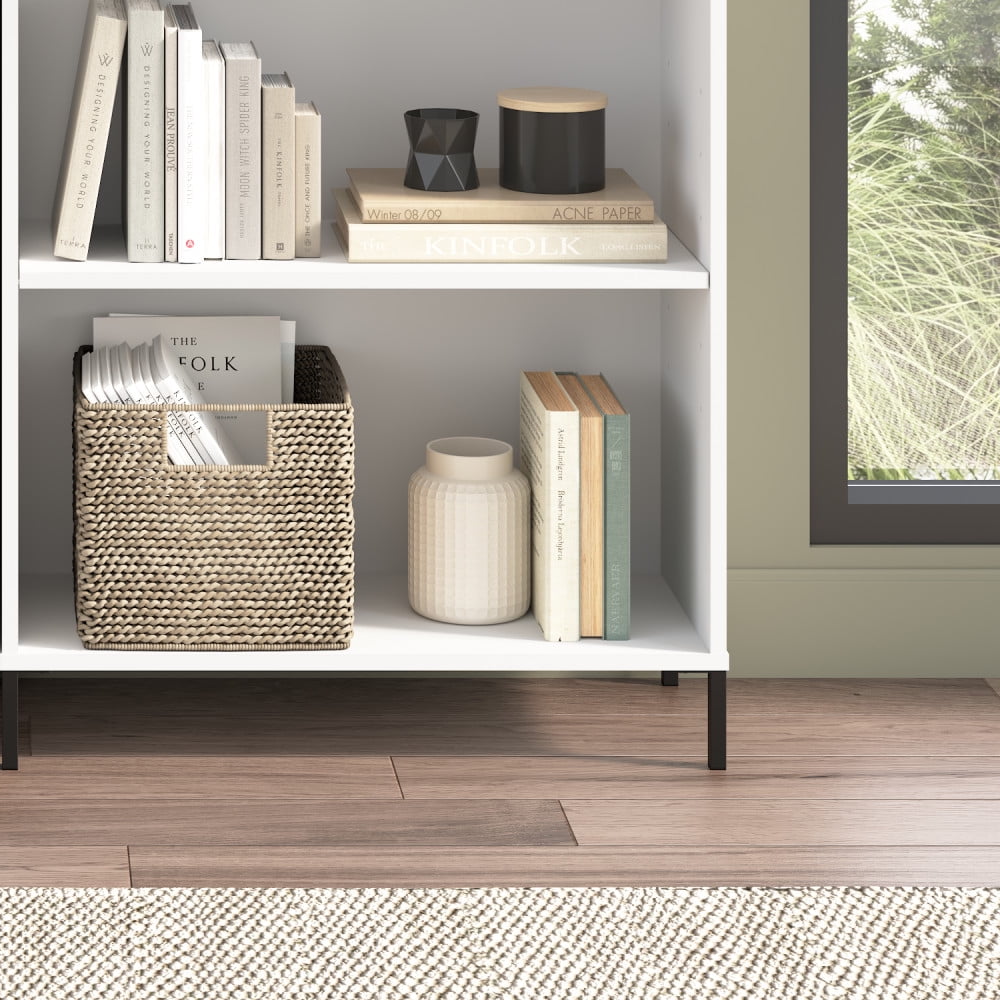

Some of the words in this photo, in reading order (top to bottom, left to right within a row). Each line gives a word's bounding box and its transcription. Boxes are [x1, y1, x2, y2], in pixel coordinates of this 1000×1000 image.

[239, 76, 249, 97] KING
[89, 74, 107, 132] DESIGNING
[166, 107, 175, 131] JEAN
[239, 102, 249, 134] SPIDER
[83, 136, 96, 166] YOUR
[166, 133, 176, 172] PROUVÉ
[239, 138, 249, 167] WITCH
[76, 173, 88, 209] WORLD
[239, 173, 249, 198] MOON
[366, 208, 402, 220] Winter
[404, 208, 442, 222] 08/09
[552, 206, 594, 220] ACNE
[602, 206, 642, 220] PAPER
[60, 239, 86, 248] TERRA
[425, 237, 582, 257] KINFOLK
[170, 337, 197, 346] THE
[179, 356, 239, 372] FOLK
